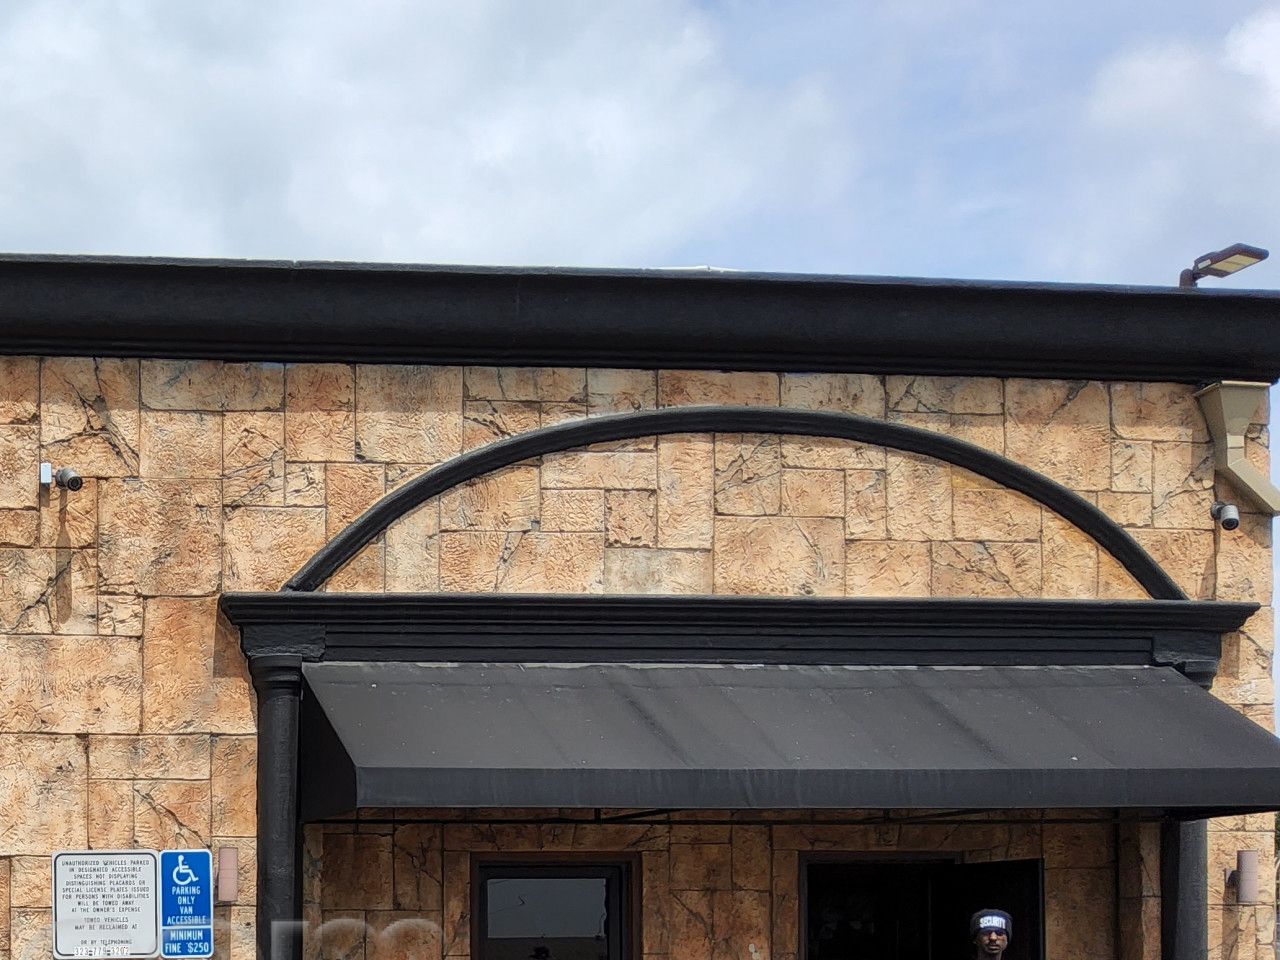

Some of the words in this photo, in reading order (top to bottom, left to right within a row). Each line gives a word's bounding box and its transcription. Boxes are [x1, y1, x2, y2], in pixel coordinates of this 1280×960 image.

[172, 886, 200, 895] PARKING
[177, 896, 195, 904] ONLY
[180, 906, 193, 914] VAN
[167, 916, 206, 925] ACCESSIBLE
[980, 916, 1006, 930] SECURITY
[170, 930, 203, 940] MINIMUM
[165, 943, 181, 953] FINE
[187, 942, 209, 953] $250
